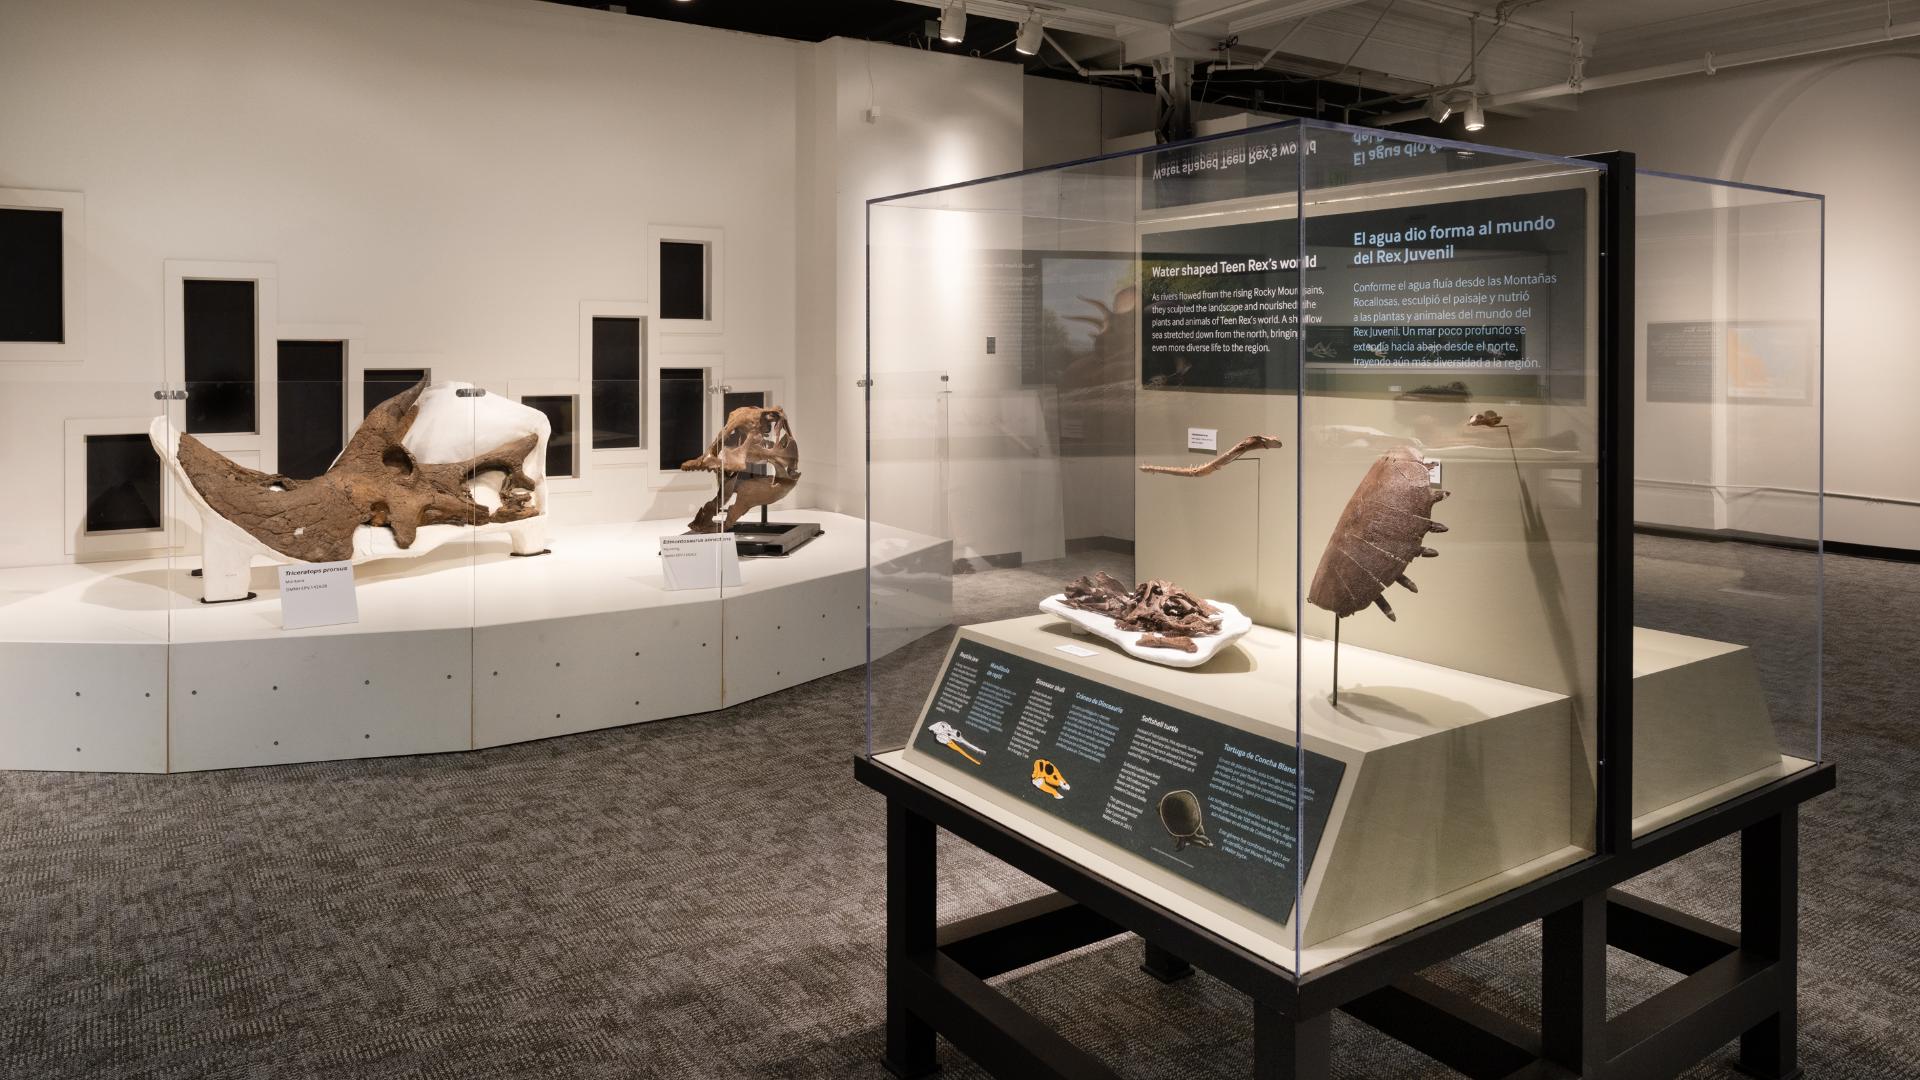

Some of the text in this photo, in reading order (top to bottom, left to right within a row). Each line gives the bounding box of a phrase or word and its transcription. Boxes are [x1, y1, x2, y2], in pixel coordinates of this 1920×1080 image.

[1354, 216, 1555, 247] El agua dio forma al mundo
[1354, 245, 1454, 265] del Rex Juvenil
[1152, 266, 1180, 278] Water
[1182, 262, 1218, 278] shaped
[1220, 261, 1245, 273] Teen
[1248, 258, 1277, 272] Rex's
[1354, 273, 1557, 293] Conforme el agua fluía desde las Montañas
[1152, 293, 1160, 301] As
[1161, 293, 1178, 301] rivers
[1179, 292, 1201, 300] flowed
[1202, 291, 1219, 299] from
[1220, 290, 1232, 298] the
[1233, 289, 1253, 300] rising
[1254, 287, 1276, 298] Rocky
[1402, 294, 1440, 306] esculpió
[1443, 294, 1451, 304] el
[1454, 292, 1487, 307] paisaje
[1489, 295, 1495, 304] y
[1498, 290, 1530, 302] nutrió
[1152, 305, 1166, 315] they
[1167, 304, 1194, 314] sculpted
[1196, 304, 1207, 312] the
[1208, 304, 1243, 312] landscape
[1245, 302, 1258, 310] and
[1260, 301, 1298, 310] nourished
[1152, 318, 1171, 328] plants
[1172, 318, 1184, 326] and
[1185, 317, 1210, 326] animals
[1212, 317, 1219, 325] of
[1220, 316, 1238, 325] Teen
[1239, 316, 1256, 325] Rex's
[1258, 315, 1280, 324] world.
[1360, 312, 1372, 321] las
[1373, 312, 1405, 324] plantas
[1407, 314, 1412, 323] y
[1414, 310, 1456, 320] animales
[1458, 309, 1473, 320] del
[1476, 308, 1512, 319] mundo
[1515, 308, 1531, 318] del
[1164, 331, 1194, 339] stretched
[1196, 331, 1214, 339] down
[1215, 330, 1232, 338] from
[1233, 330, 1245, 338] the
[1247, 330, 1269, 339] north,
[1354, 325, 1526, 338] Rex Juvenil. Un mar poco profundo se
[1168, 344, 1185, 352] more
[1187, 344, 1210, 352] diverse
[1211, 343, 1221, 352] life
[1232, 343, 1244, 351] the
[1245, 344, 1270, 354] region.
[1392, 342, 1415, 351] hacia
[1444, 341, 1474, 351] desde
[1476, 341, 1485, 351] el
[1487, 342, 1519, 352] norte,
[1434, 357, 1483, 367] diversidad
[1485, 360, 1490, 368] a
[1494, 357, 1501, 368] la
[1504, 357, 1542, 370] región.
